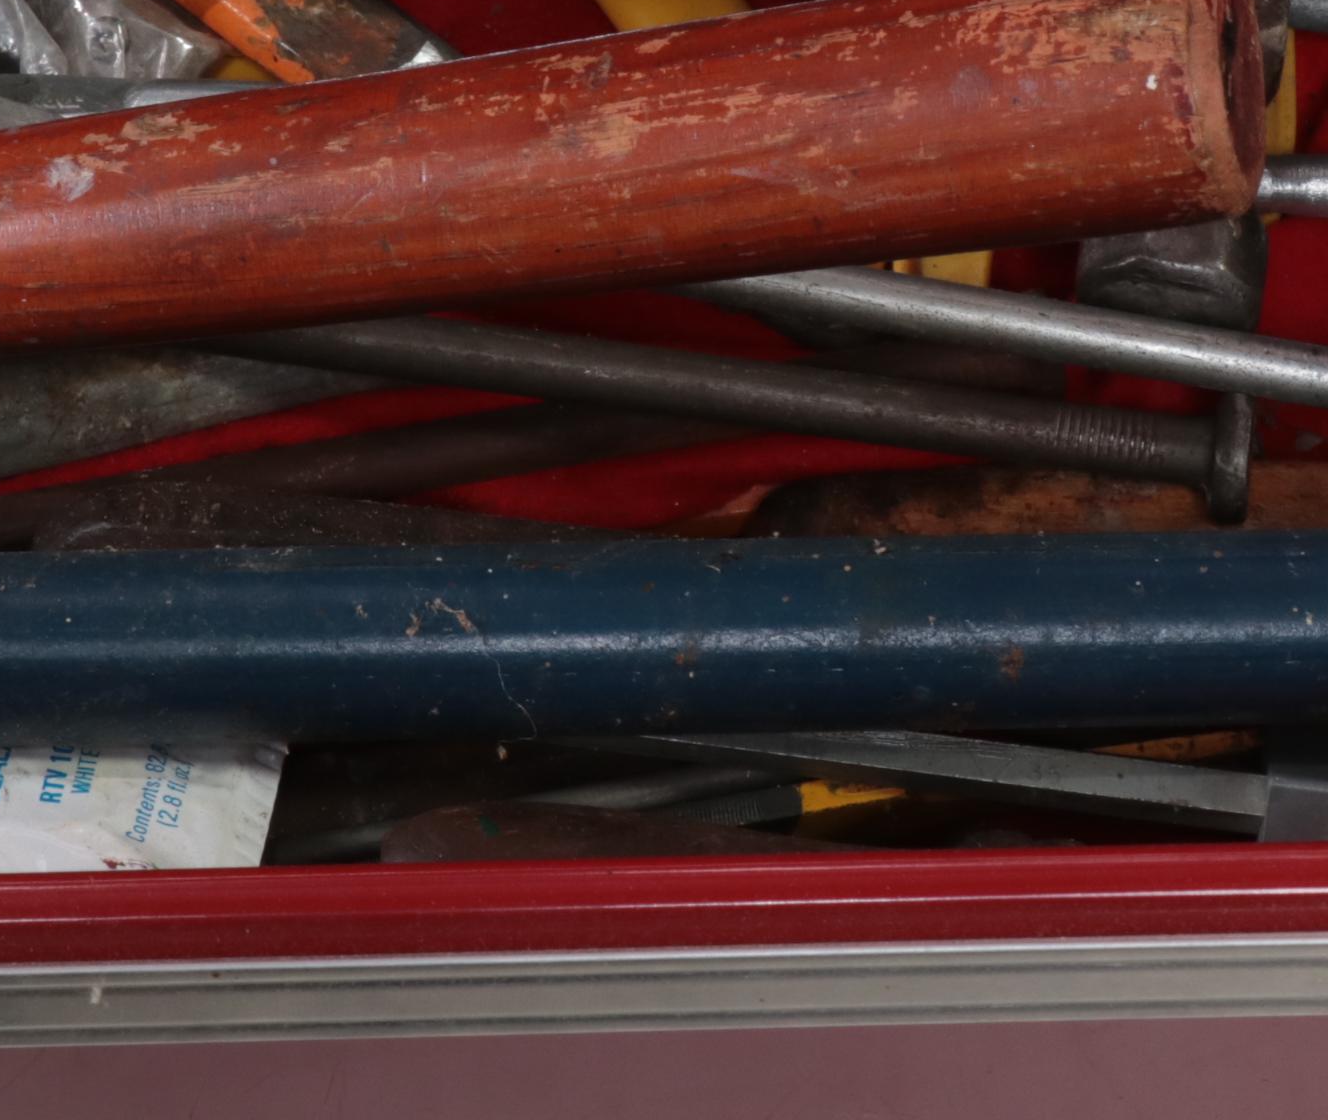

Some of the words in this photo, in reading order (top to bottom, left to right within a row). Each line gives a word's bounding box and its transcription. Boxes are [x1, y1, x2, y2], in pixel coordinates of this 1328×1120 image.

[39, 768, 68, 804] RTV
[71, 747, 100, 794] WHITE
[125, 776, 161, 843] Contents:
[156, 795, 183, 828] (2.8
